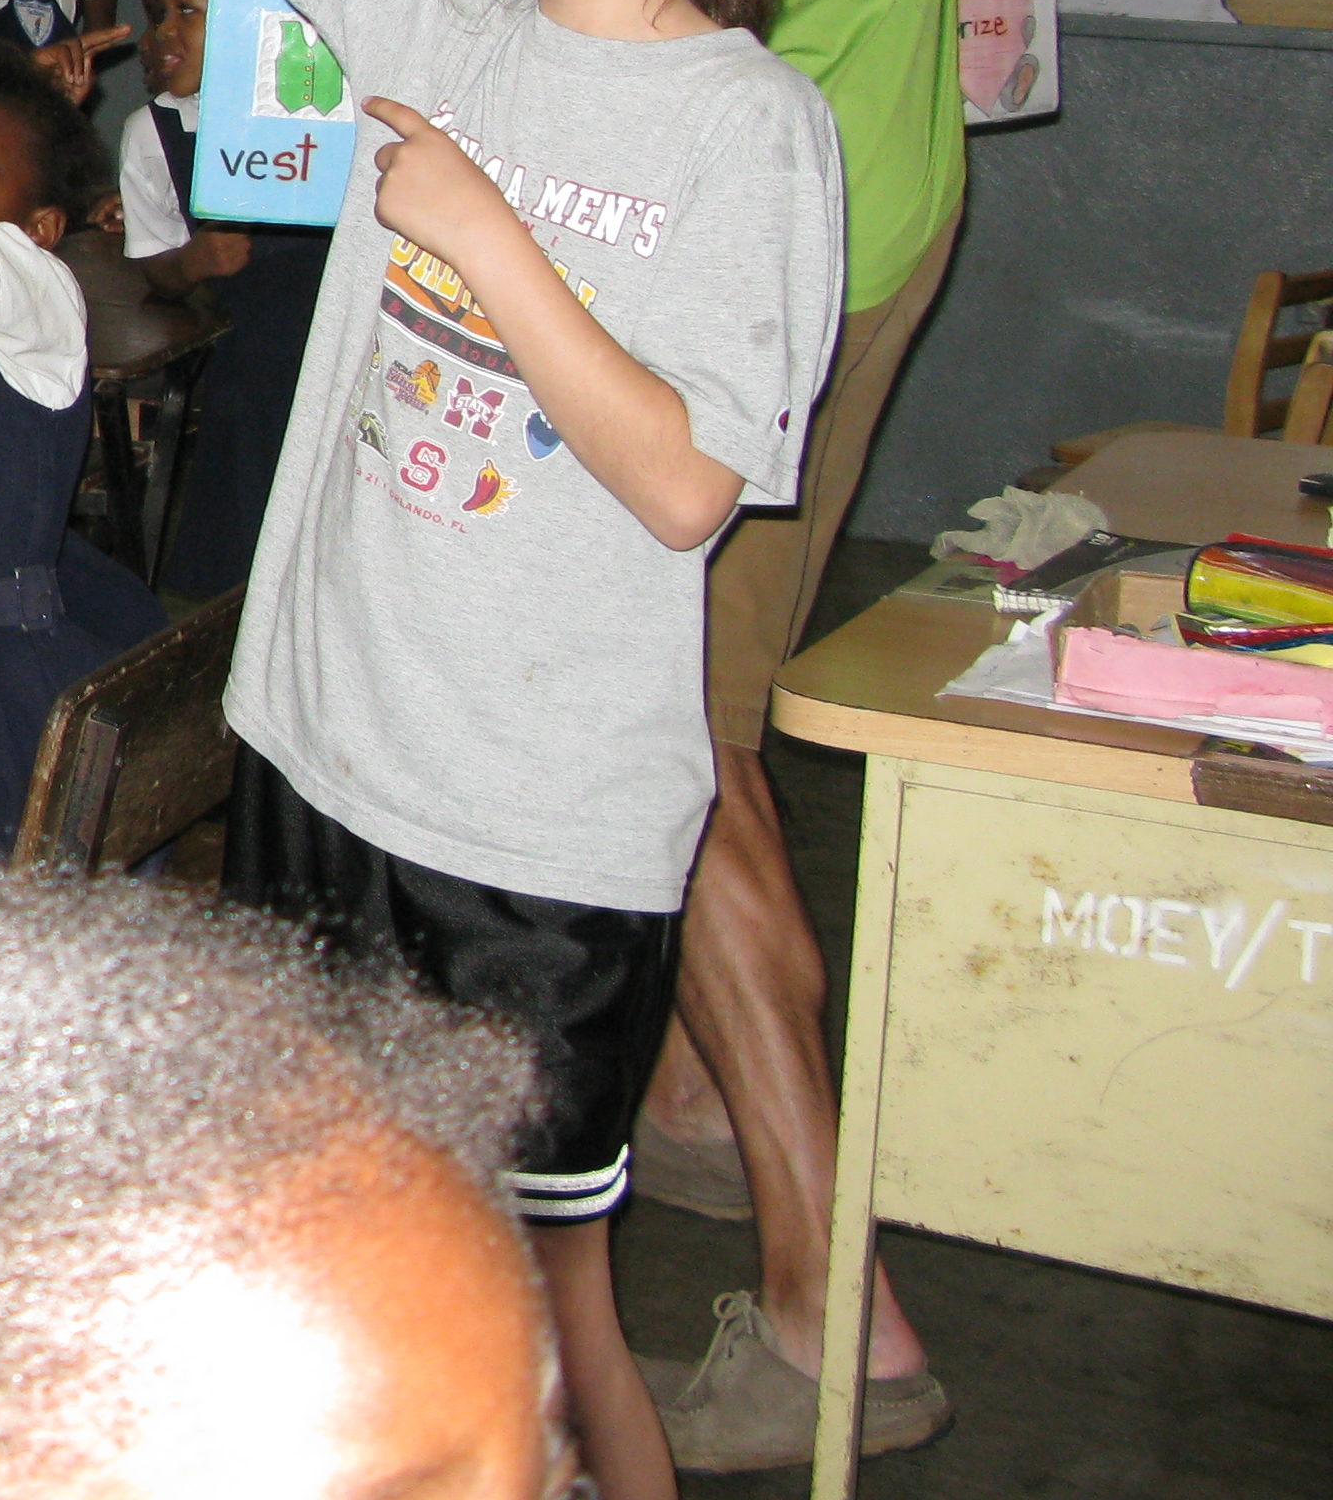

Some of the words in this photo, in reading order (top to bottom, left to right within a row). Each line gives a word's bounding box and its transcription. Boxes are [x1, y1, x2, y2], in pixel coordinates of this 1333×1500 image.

[220, 133, 318, 183] vest
[531, 174, 668, 259] MEN'S
[455, 396, 492, 423] STATE
